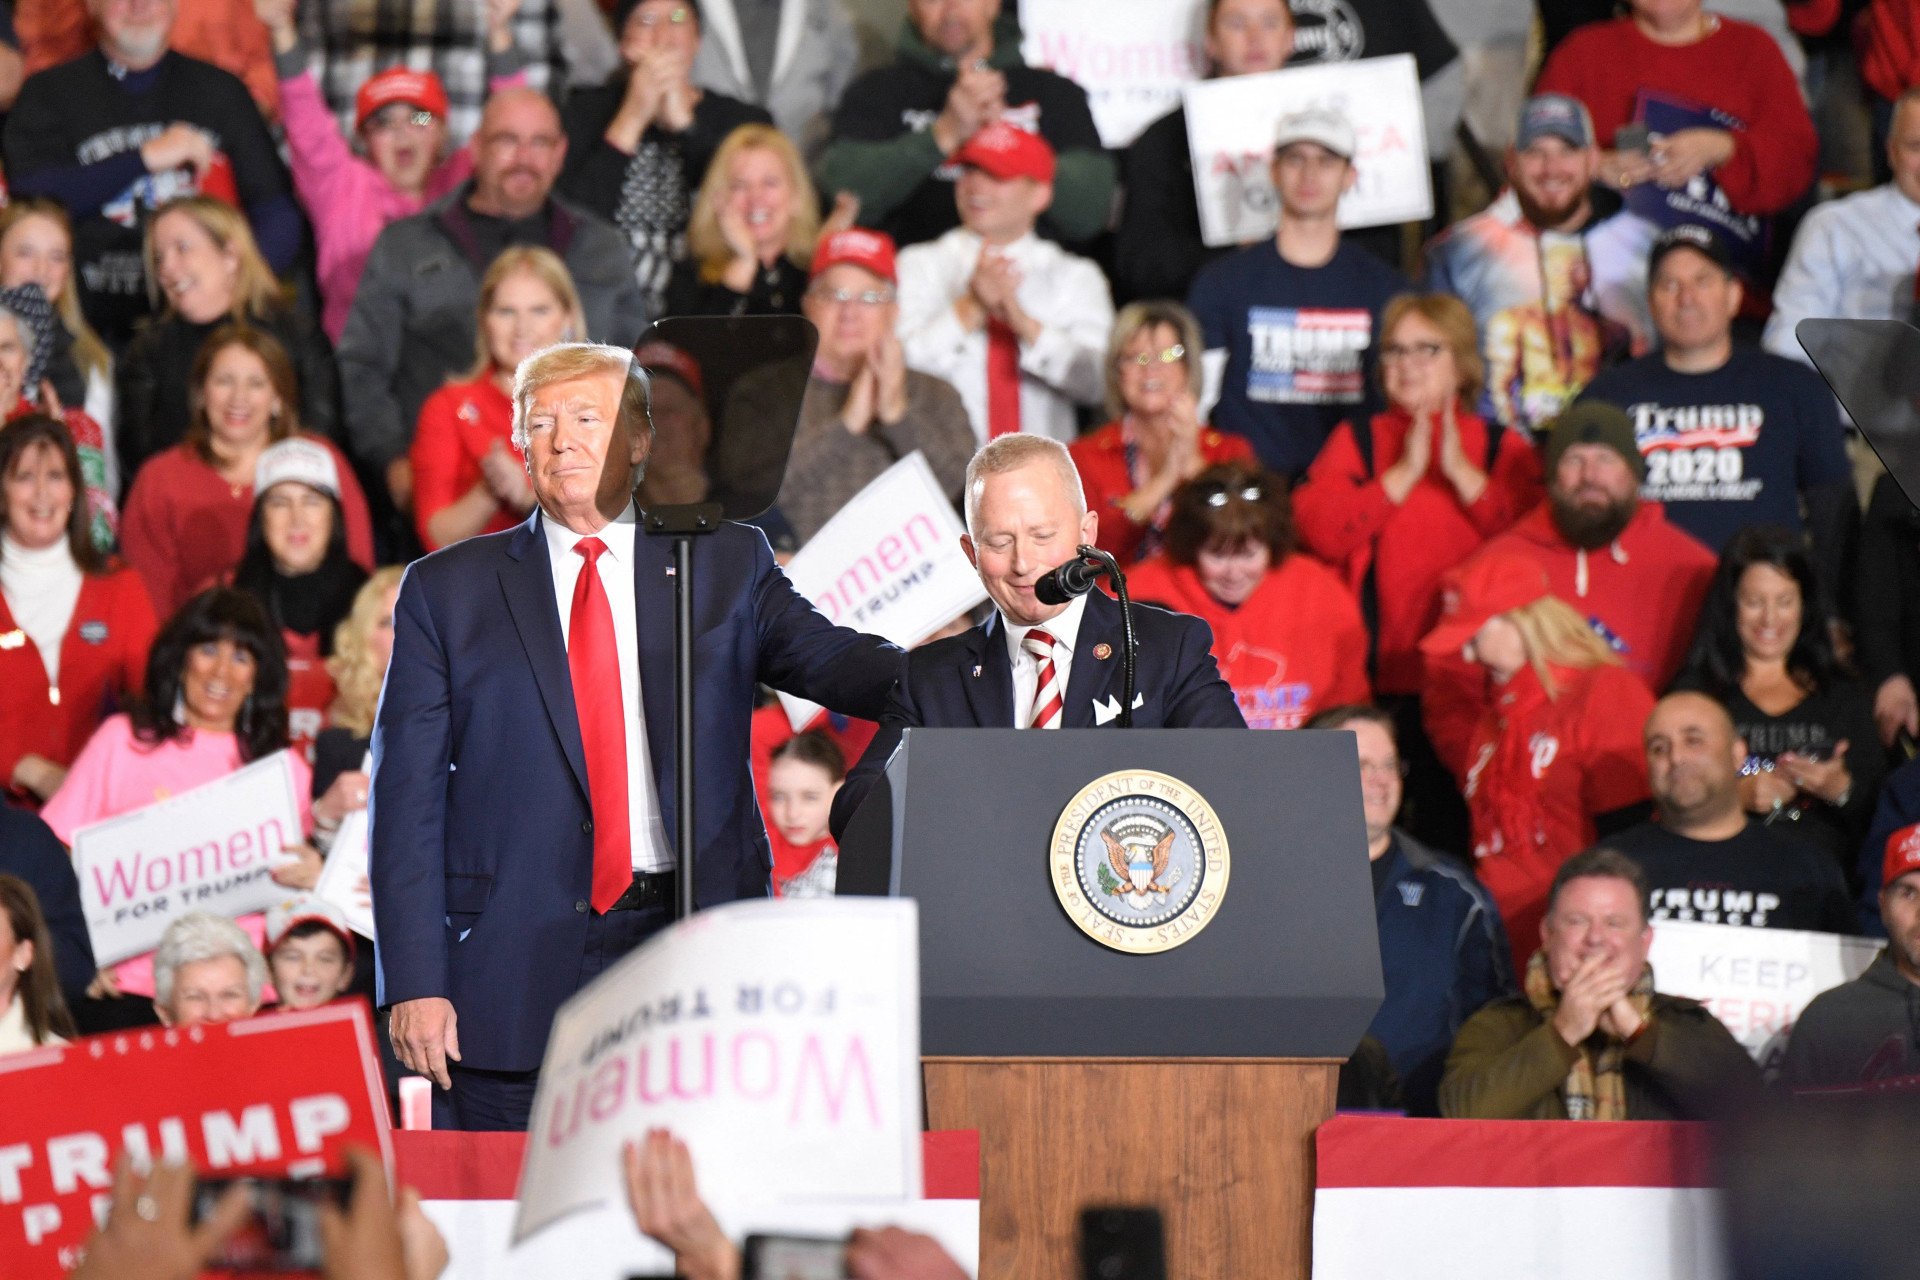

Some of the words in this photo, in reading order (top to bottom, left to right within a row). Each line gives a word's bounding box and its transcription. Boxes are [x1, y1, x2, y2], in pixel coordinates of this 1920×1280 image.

[1247, 324, 1371, 354] TRUMP
[1626, 402, 1764, 441] Trump
[1645, 447, 1743, 484] 2020
[853, 560, 935, 623] TRUMP
[1139, 779, 1156, 791] OF
[1159, 782, 1182, 801] THE
[1058, 777, 1134, 857] PRESIDENT
[1185, 799, 1223, 873] UNITED
[91, 817, 287, 908] Women
[1059, 863, 1073, 888] THE
[114, 895, 170, 924] FOR
[179, 864, 271, 905] TRUMP
[1066, 891, 1081, 907] OF
[1082, 907, 1126, 944] SEAL
[1156, 888, 1217, 944] STATES
[1700, 953, 1809, 989] KEEP
[738, 981, 838, 1017] FOR
[547, 1027, 884, 1148] Women
[0, 1091, 352, 1205] TRUMP
